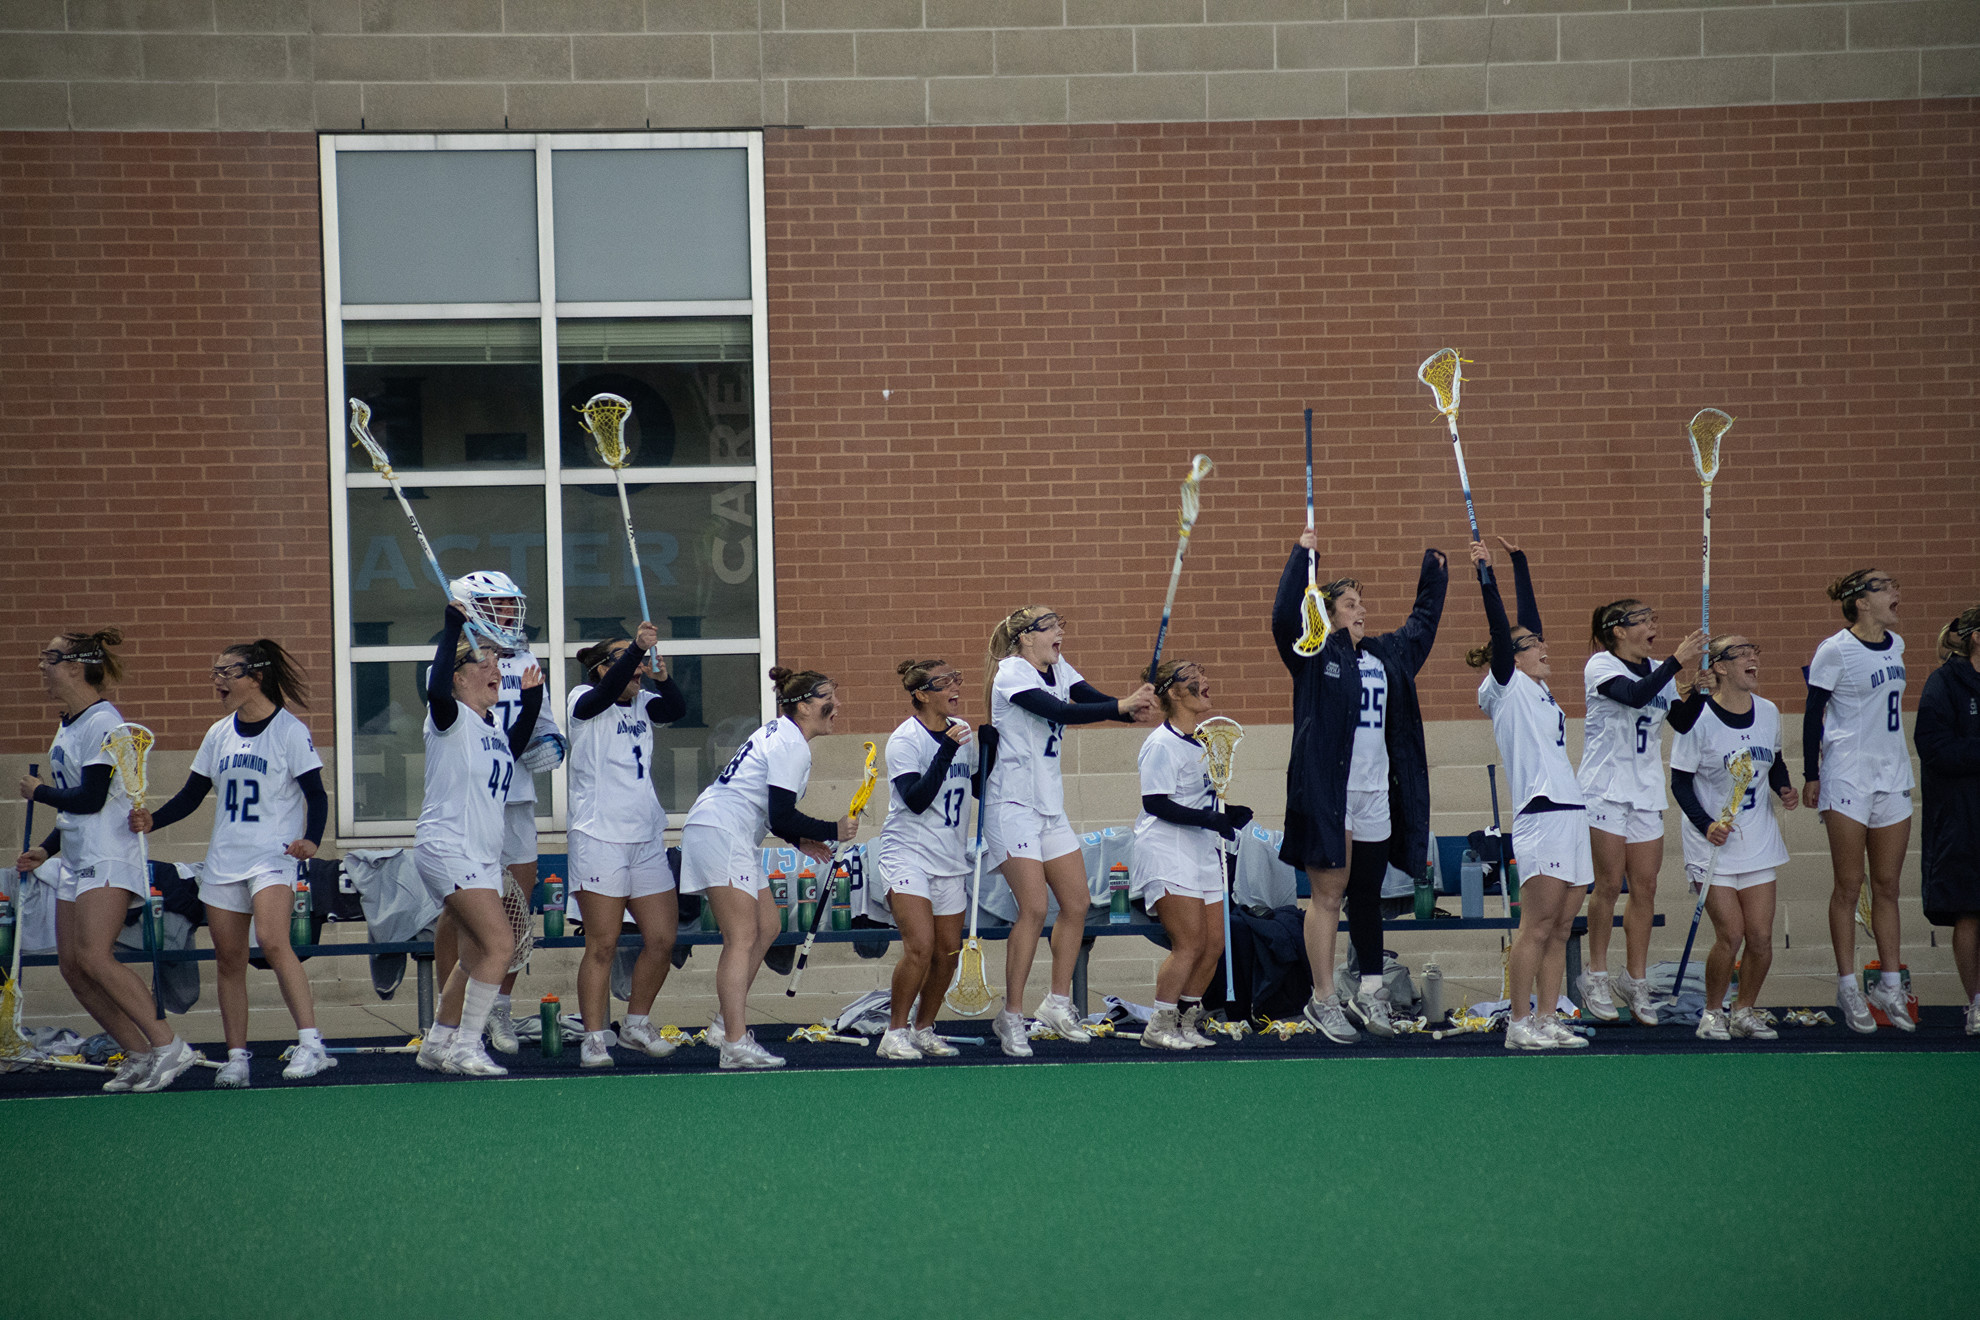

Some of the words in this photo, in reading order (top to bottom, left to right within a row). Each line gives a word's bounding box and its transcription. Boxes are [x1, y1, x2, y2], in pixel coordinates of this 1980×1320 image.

[409, 515, 422, 536] STX
[1360, 688, 1385, 728] 25
[1888, 690, 1899, 732] 8
[1636, 716, 1652, 753] 6
[232, 753, 268, 776] DOMINION
[488, 759, 514, 803] 44
[632, 745, 644, 779] 1
[225, 779, 260, 823] 42
[944, 788, 965, 827] 13
